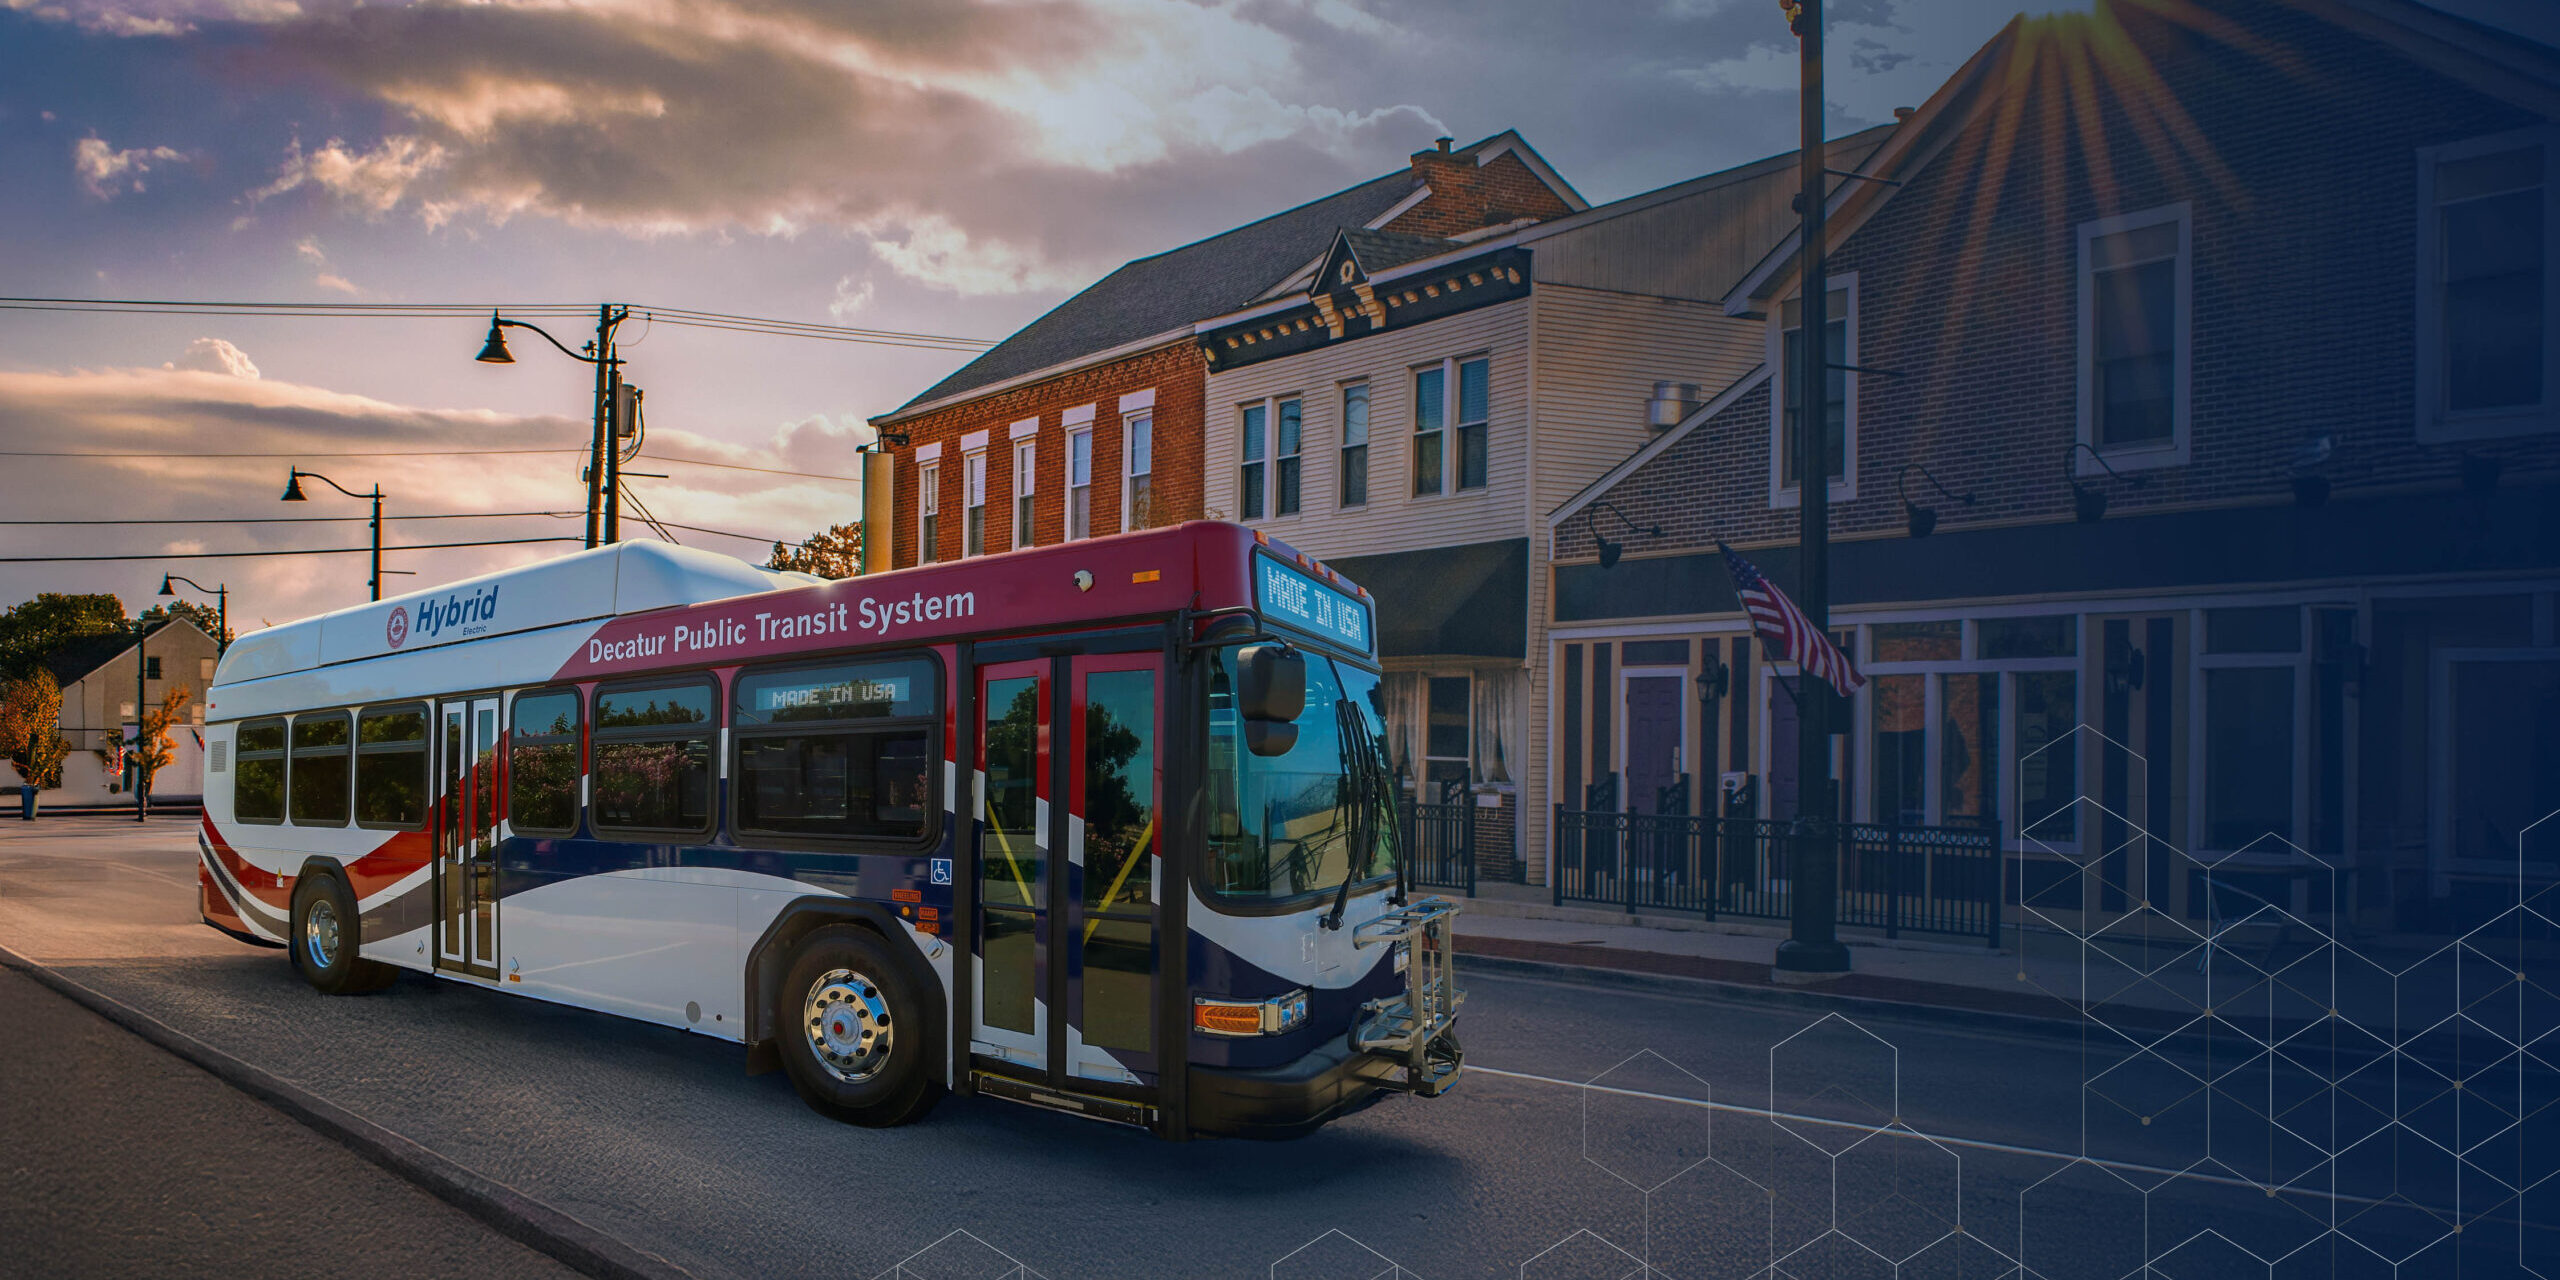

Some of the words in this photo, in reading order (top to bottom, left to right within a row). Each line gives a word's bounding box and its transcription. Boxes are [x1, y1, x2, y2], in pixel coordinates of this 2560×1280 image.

[415, 585, 500, 637] Hybrid
[589, 631, 666, 664] Decatur
[674, 616, 747, 653] Public
[755, 603, 848, 642] Transit
[858, 591, 975, 635] System
[1267, 566, 1309, 618] MADE
[1314, 589, 1334, 629] IN
[1337, 600, 1362, 642] USA
[462, 625, 487, 636] Electric
[772, 687, 820, 708] MADE
[830, 685, 853, 703] IN
[862, 683, 896, 701] USA
